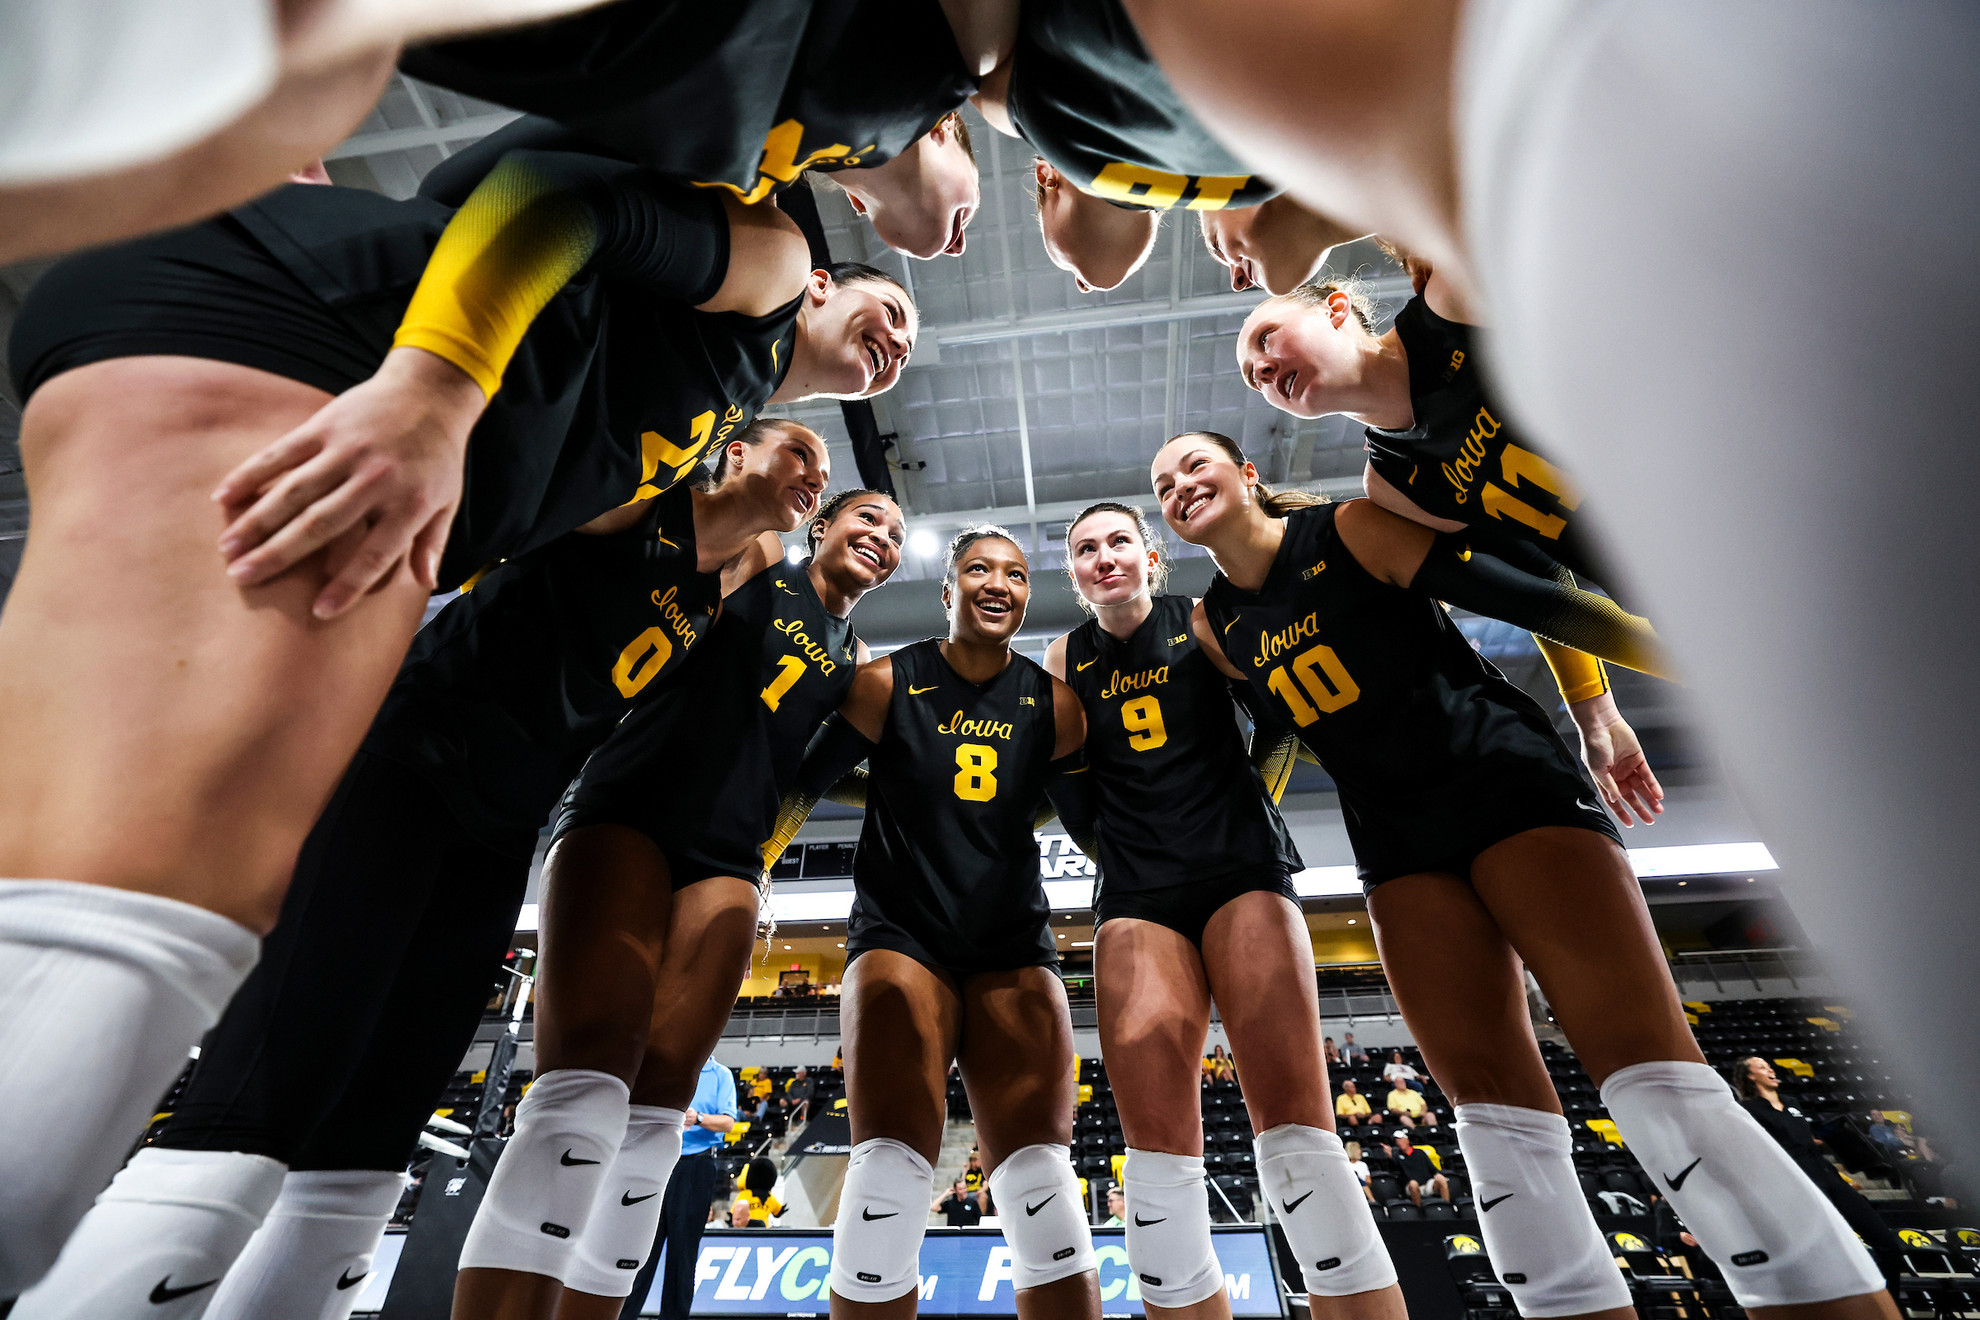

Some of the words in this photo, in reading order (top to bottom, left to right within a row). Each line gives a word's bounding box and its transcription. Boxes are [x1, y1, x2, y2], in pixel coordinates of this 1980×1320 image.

[1442, 407, 1502, 504] Iowa
[1481, 442, 1582, 541] 11
[651, 586, 697, 650] Iowa
[774, 618, 837, 677] Iowa
[1254, 611, 1320, 667] Iowa
[612, 626, 673, 699] 0
[761, 655, 808, 713] 1
[1101, 665, 1169, 699] Iowa
[1267, 643, 1361, 728] 10
[937, 709, 1014, 741] Iowa
[1120, 694, 1168, 752] 9
[953, 743, 998, 802] 8
